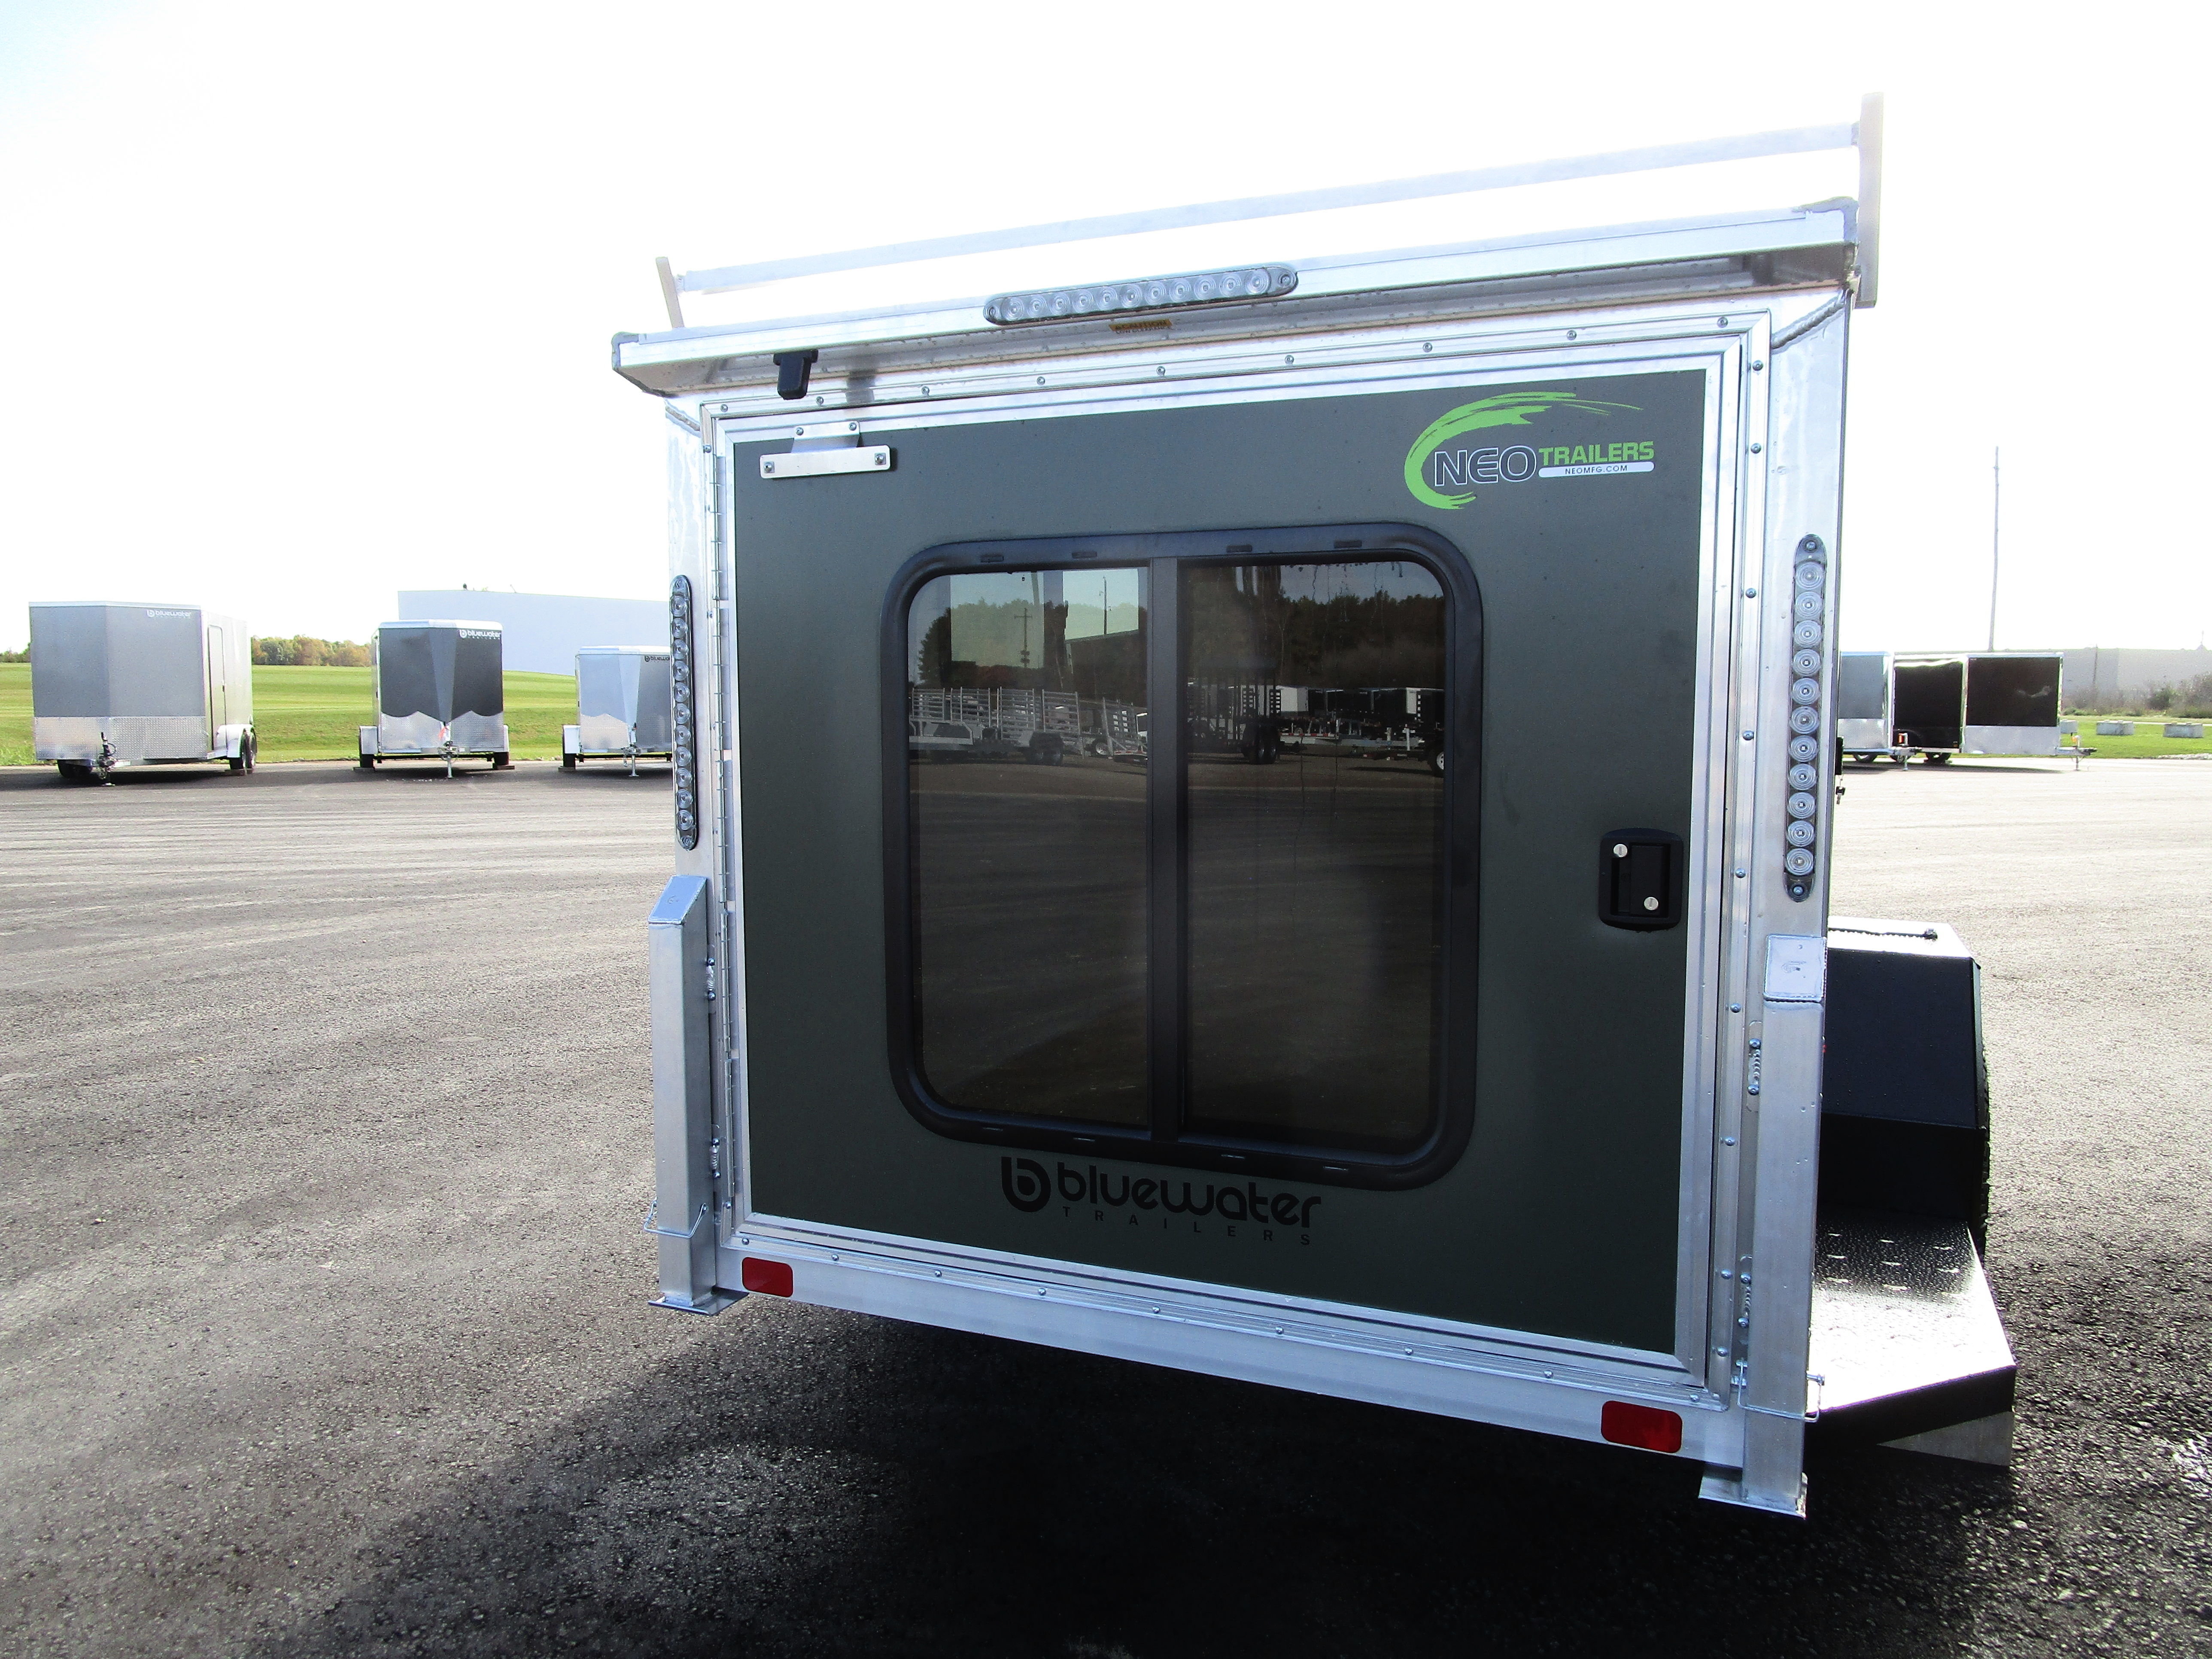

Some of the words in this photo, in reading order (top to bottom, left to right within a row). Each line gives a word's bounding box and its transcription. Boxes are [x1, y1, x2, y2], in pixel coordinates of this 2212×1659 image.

[1434, 445, 1537, 486] NEO
[1539, 441, 1654, 466] TRAILERS
[1565, 465, 1628, 474] NEOMFG.COM
[1057, 1162, 1321, 1228] bluewater
[1062, 1206, 1310, 1246] TRAILERS
